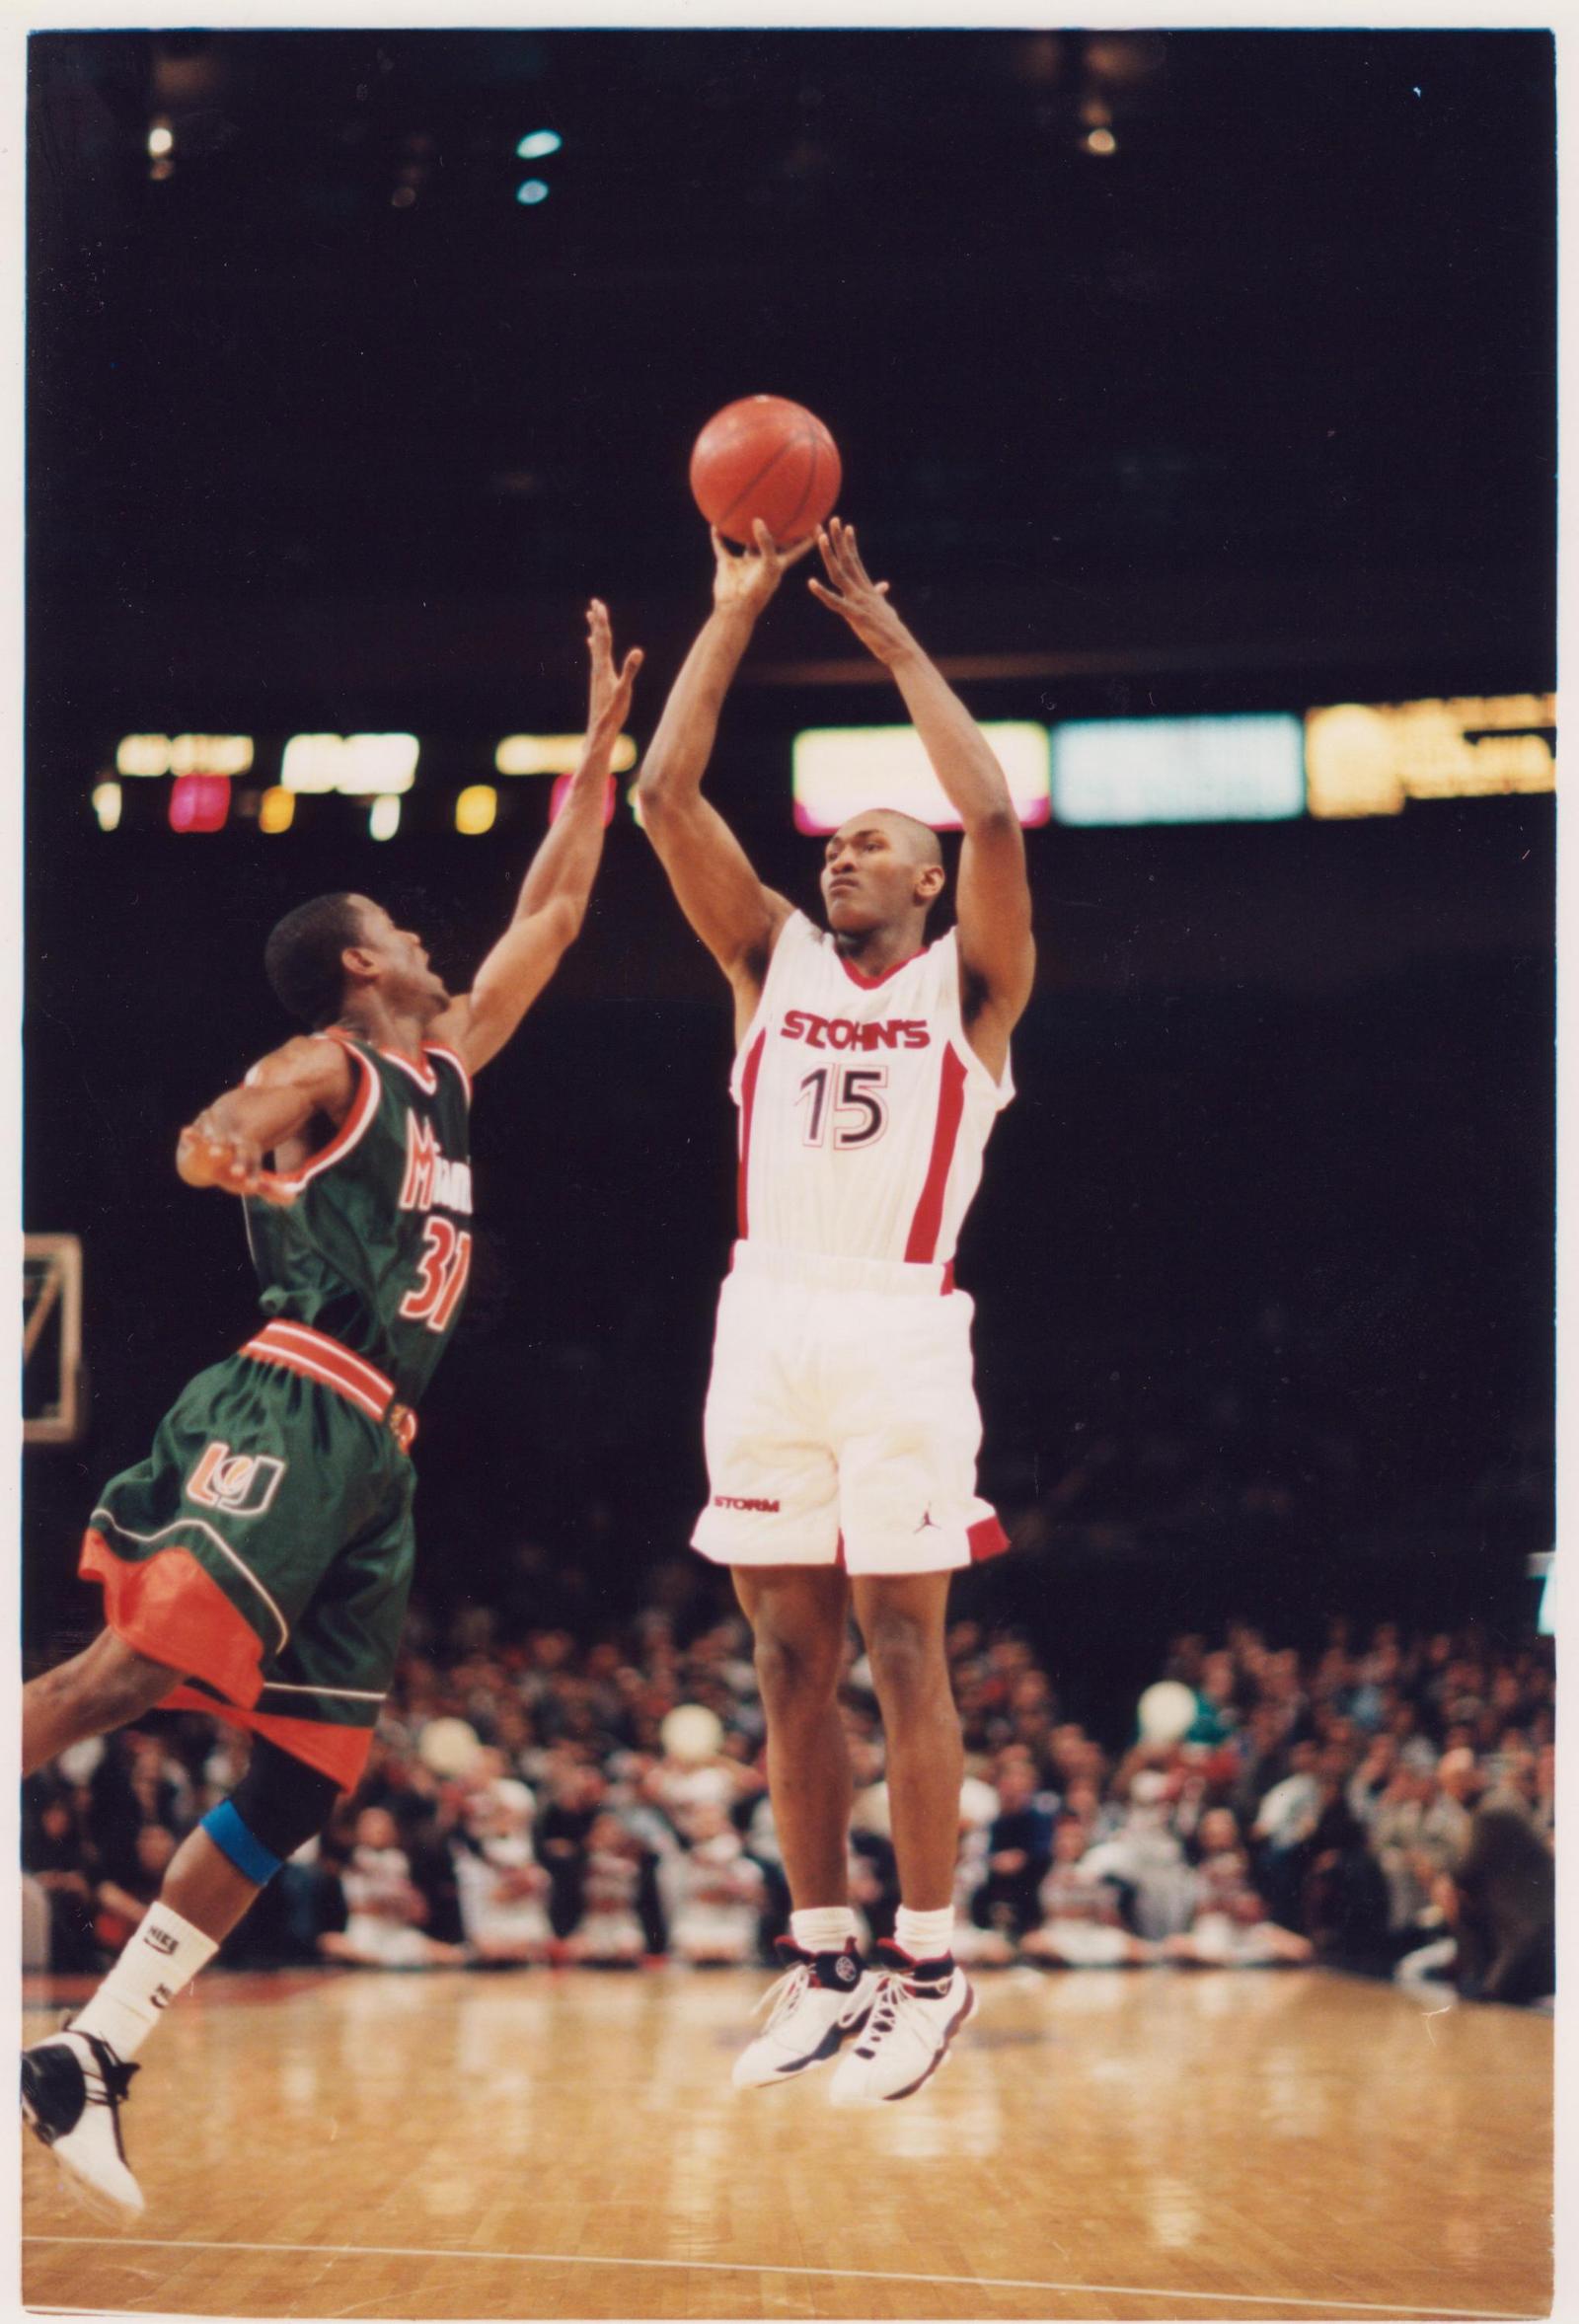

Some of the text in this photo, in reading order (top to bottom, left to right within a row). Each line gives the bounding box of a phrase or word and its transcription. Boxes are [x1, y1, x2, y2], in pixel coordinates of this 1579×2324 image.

[794, 1063, 888, 1151] 15
[400, 1216, 472, 1331] 31
[714, 1495, 781, 1513] STORM
